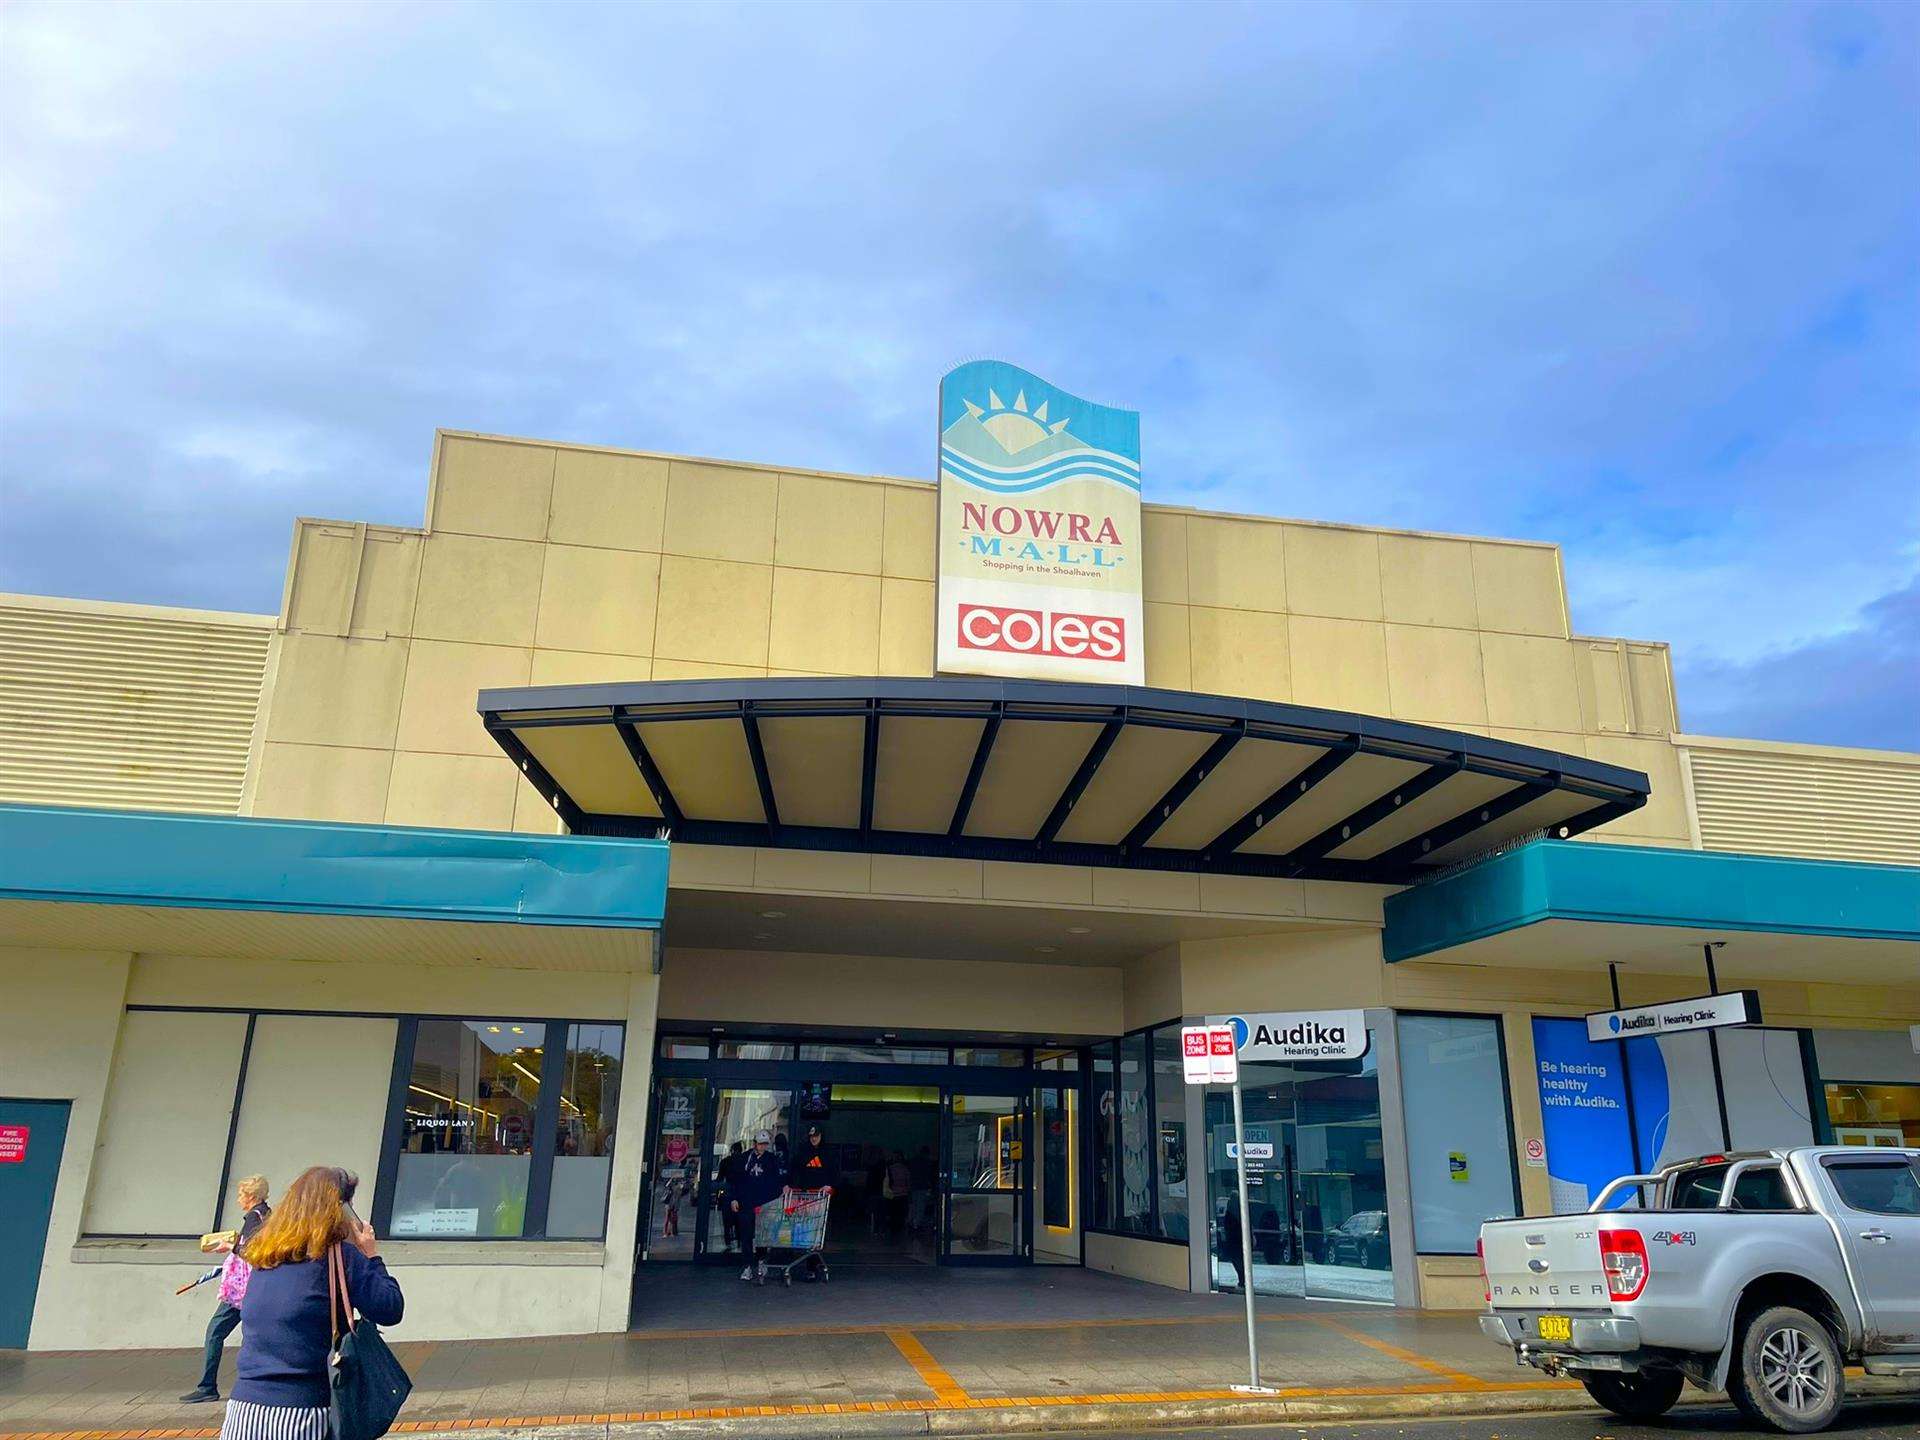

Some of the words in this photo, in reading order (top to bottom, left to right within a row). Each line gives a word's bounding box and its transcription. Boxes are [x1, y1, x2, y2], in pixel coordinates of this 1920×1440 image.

[962, 502, 1122, 545] NOWRA
[983, 560, 1024, 572] Shopping
[1026, 564, 1034, 572] in
[1037, 566, 1050, 574] the
[1053, 566, 1101, 578] Shoalhaven
[961, 608, 1122, 658] coles
[1622, 1015, 1655, 1030] Audika
[1663, 1013, 1693, 1025] Hearing
[1694, 1010, 1715, 1021] Clinic
[1186, 1035, 1205, 1045] BUS
[1253, 1021, 1345, 1046] Audika
[1186, 1045, 1206, 1055] ZONE
[1214, 1044, 1231, 1053] ZONE
[1284, 1046, 1319, 1057] Hearing
[1321, 1045, 1346, 1055] Clinic
[1541, 1061, 1557, 1072] Be
[1560, 1062, 1606, 1078] hearing
[1542, 1078, 1588, 1093] healthy
[1544, 1094, 1571, 1106] with
[1574, 1095, 1620, 1108] Audika.
[1244, 1130, 1268, 1140] OPEN
[1493, 1285, 1604, 1296] RANGER
